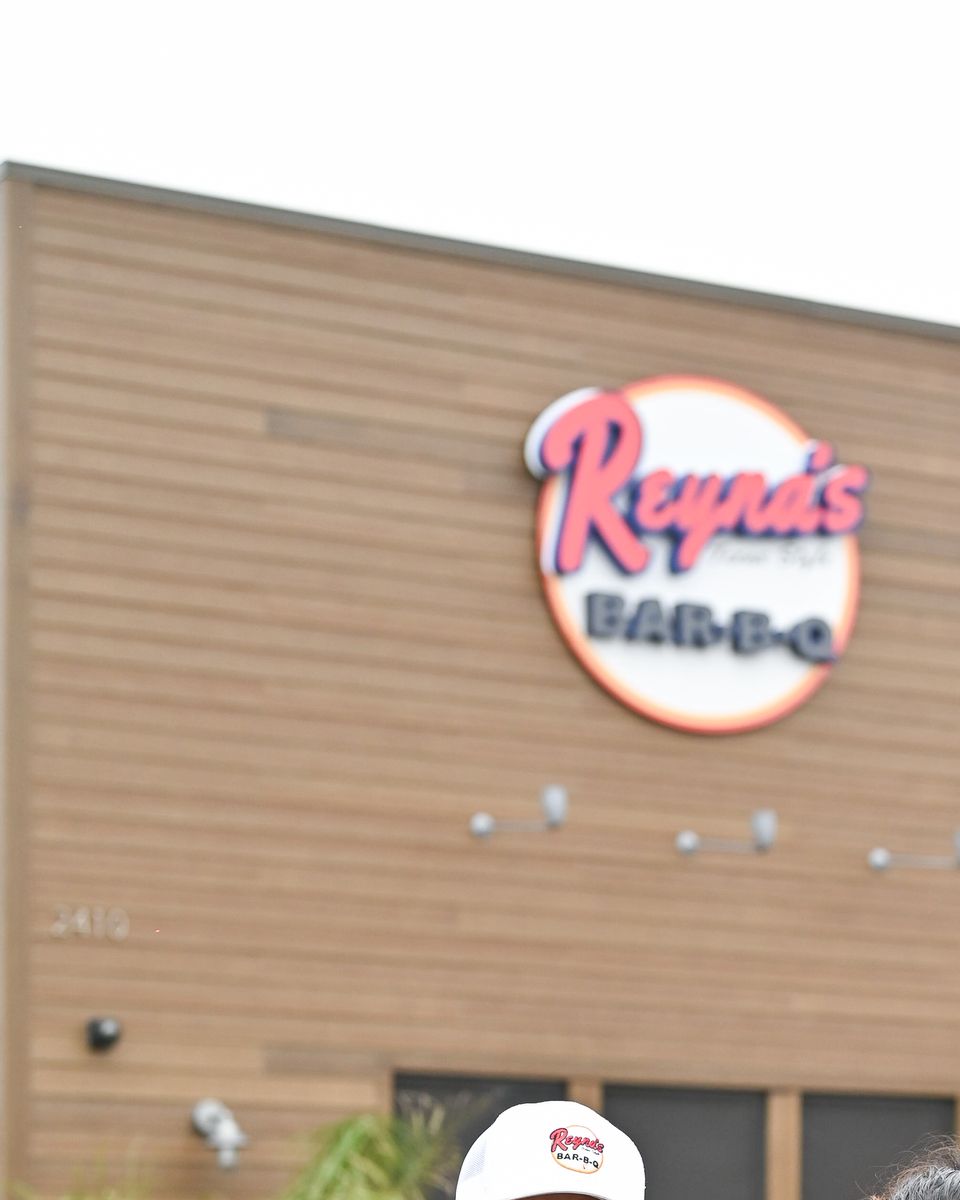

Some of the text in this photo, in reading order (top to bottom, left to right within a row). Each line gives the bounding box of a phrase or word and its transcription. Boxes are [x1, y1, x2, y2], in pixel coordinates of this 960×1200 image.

[540, 390, 869, 574] Reyna's
[584, 592, 838, 664] BAR-B-Q
[556, 1152, 600, 1169] BAR-B-Q
